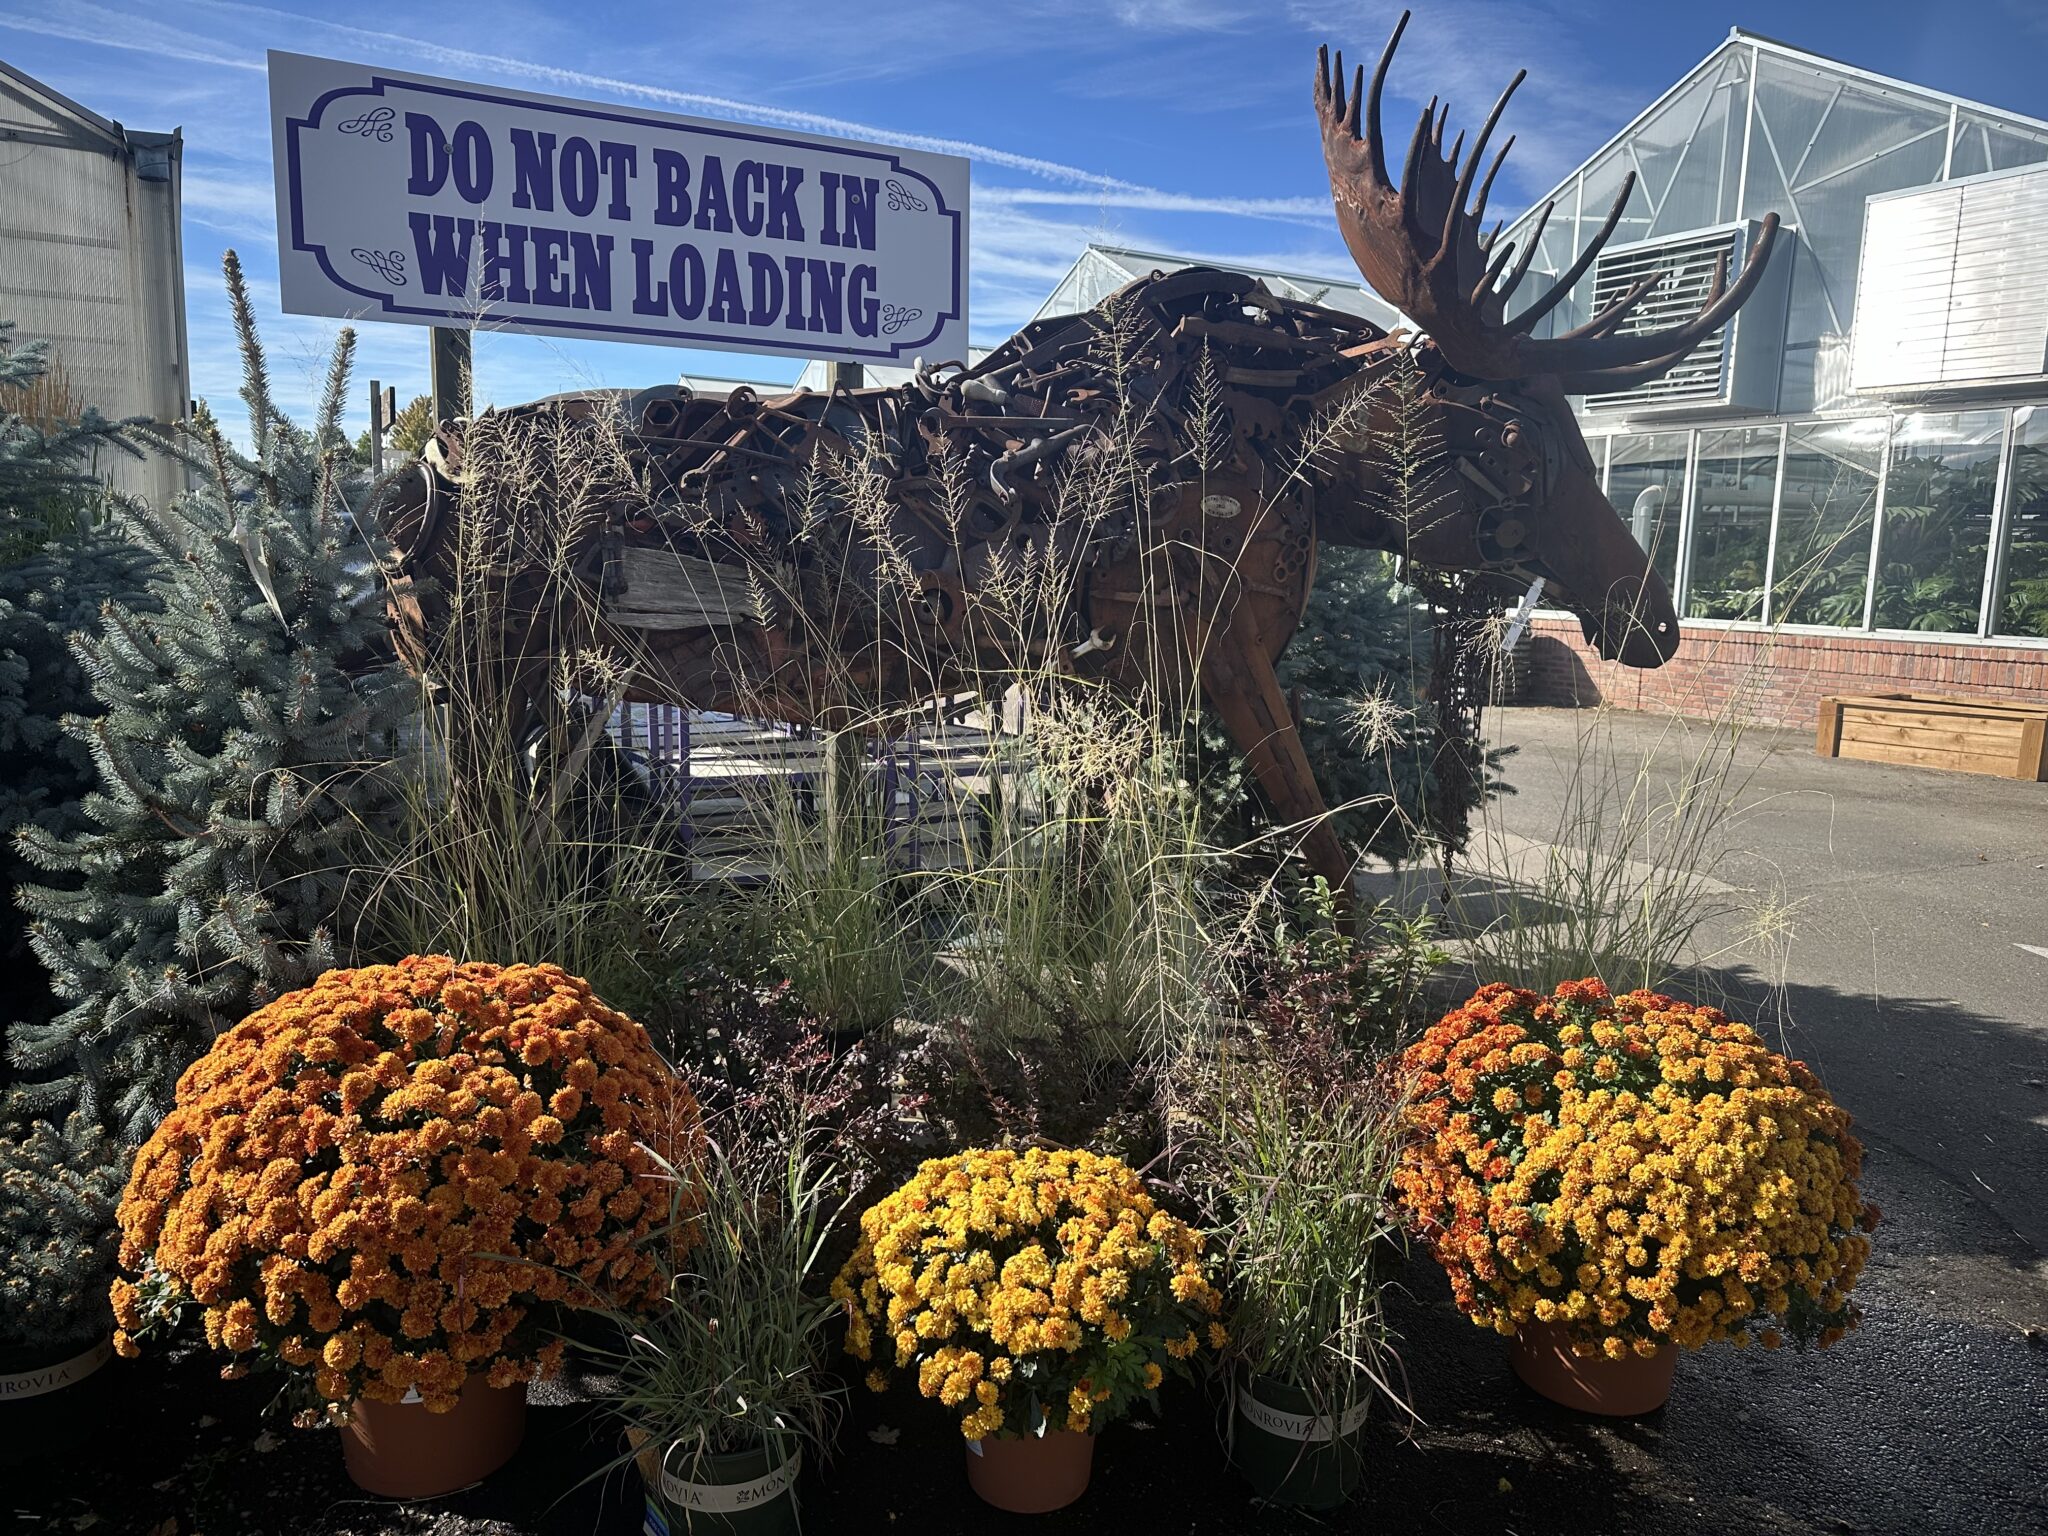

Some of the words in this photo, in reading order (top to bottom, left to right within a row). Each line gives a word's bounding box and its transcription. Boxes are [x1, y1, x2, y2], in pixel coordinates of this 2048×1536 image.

[404, 111, 494, 204] DO
[510, 127, 637, 221] NOT
[652, 149, 804, 242] BACK
[819, 171, 880, 251] IN
[408, 211, 613, 311] WHEN
[631, 238, 881, 338] LOADING
[0, 1368, 70, 1394] ROVIA
[664, 1477, 702, 1505] OVIA
